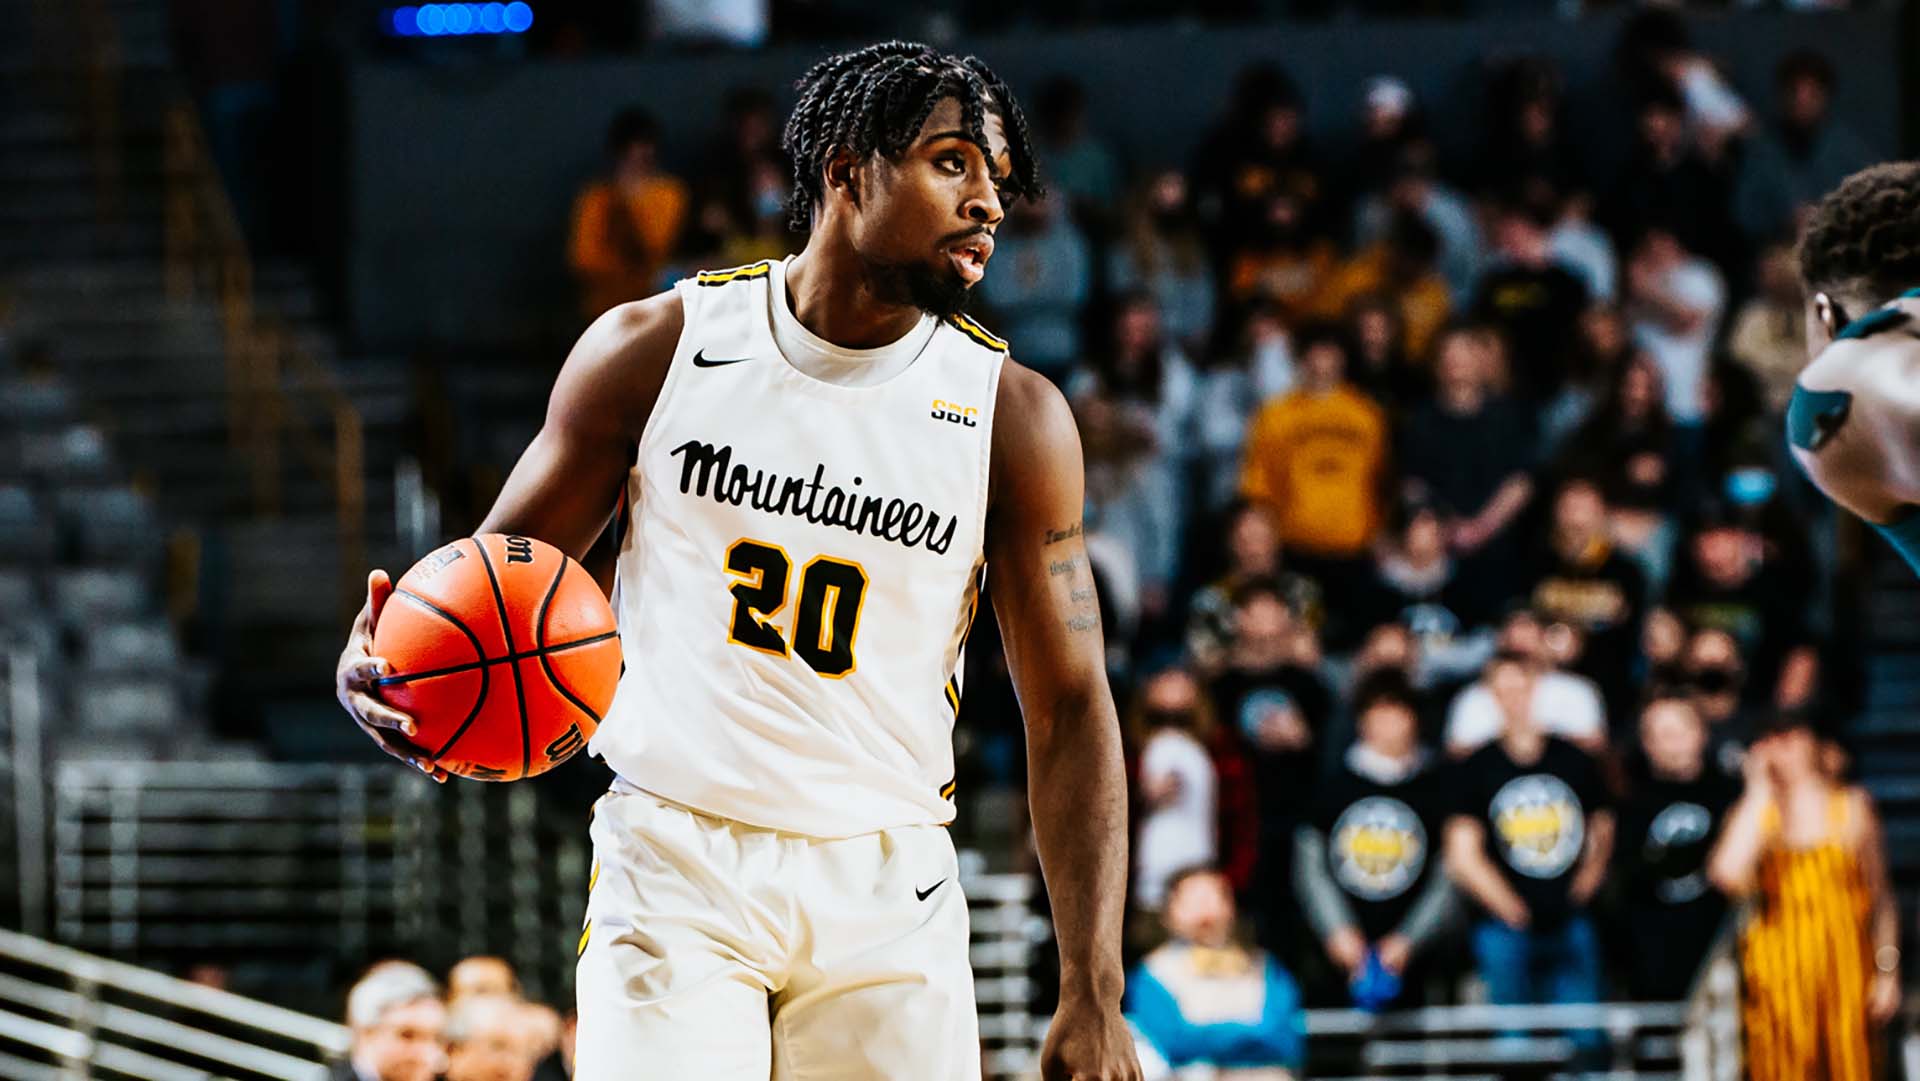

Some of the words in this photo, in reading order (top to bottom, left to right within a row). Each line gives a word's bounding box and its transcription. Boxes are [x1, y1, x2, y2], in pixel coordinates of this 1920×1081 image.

[931, 399, 978, 428] SBC
[670, 440, 957, 555] Mountaineers
[723, 537, 870, 680] 20
